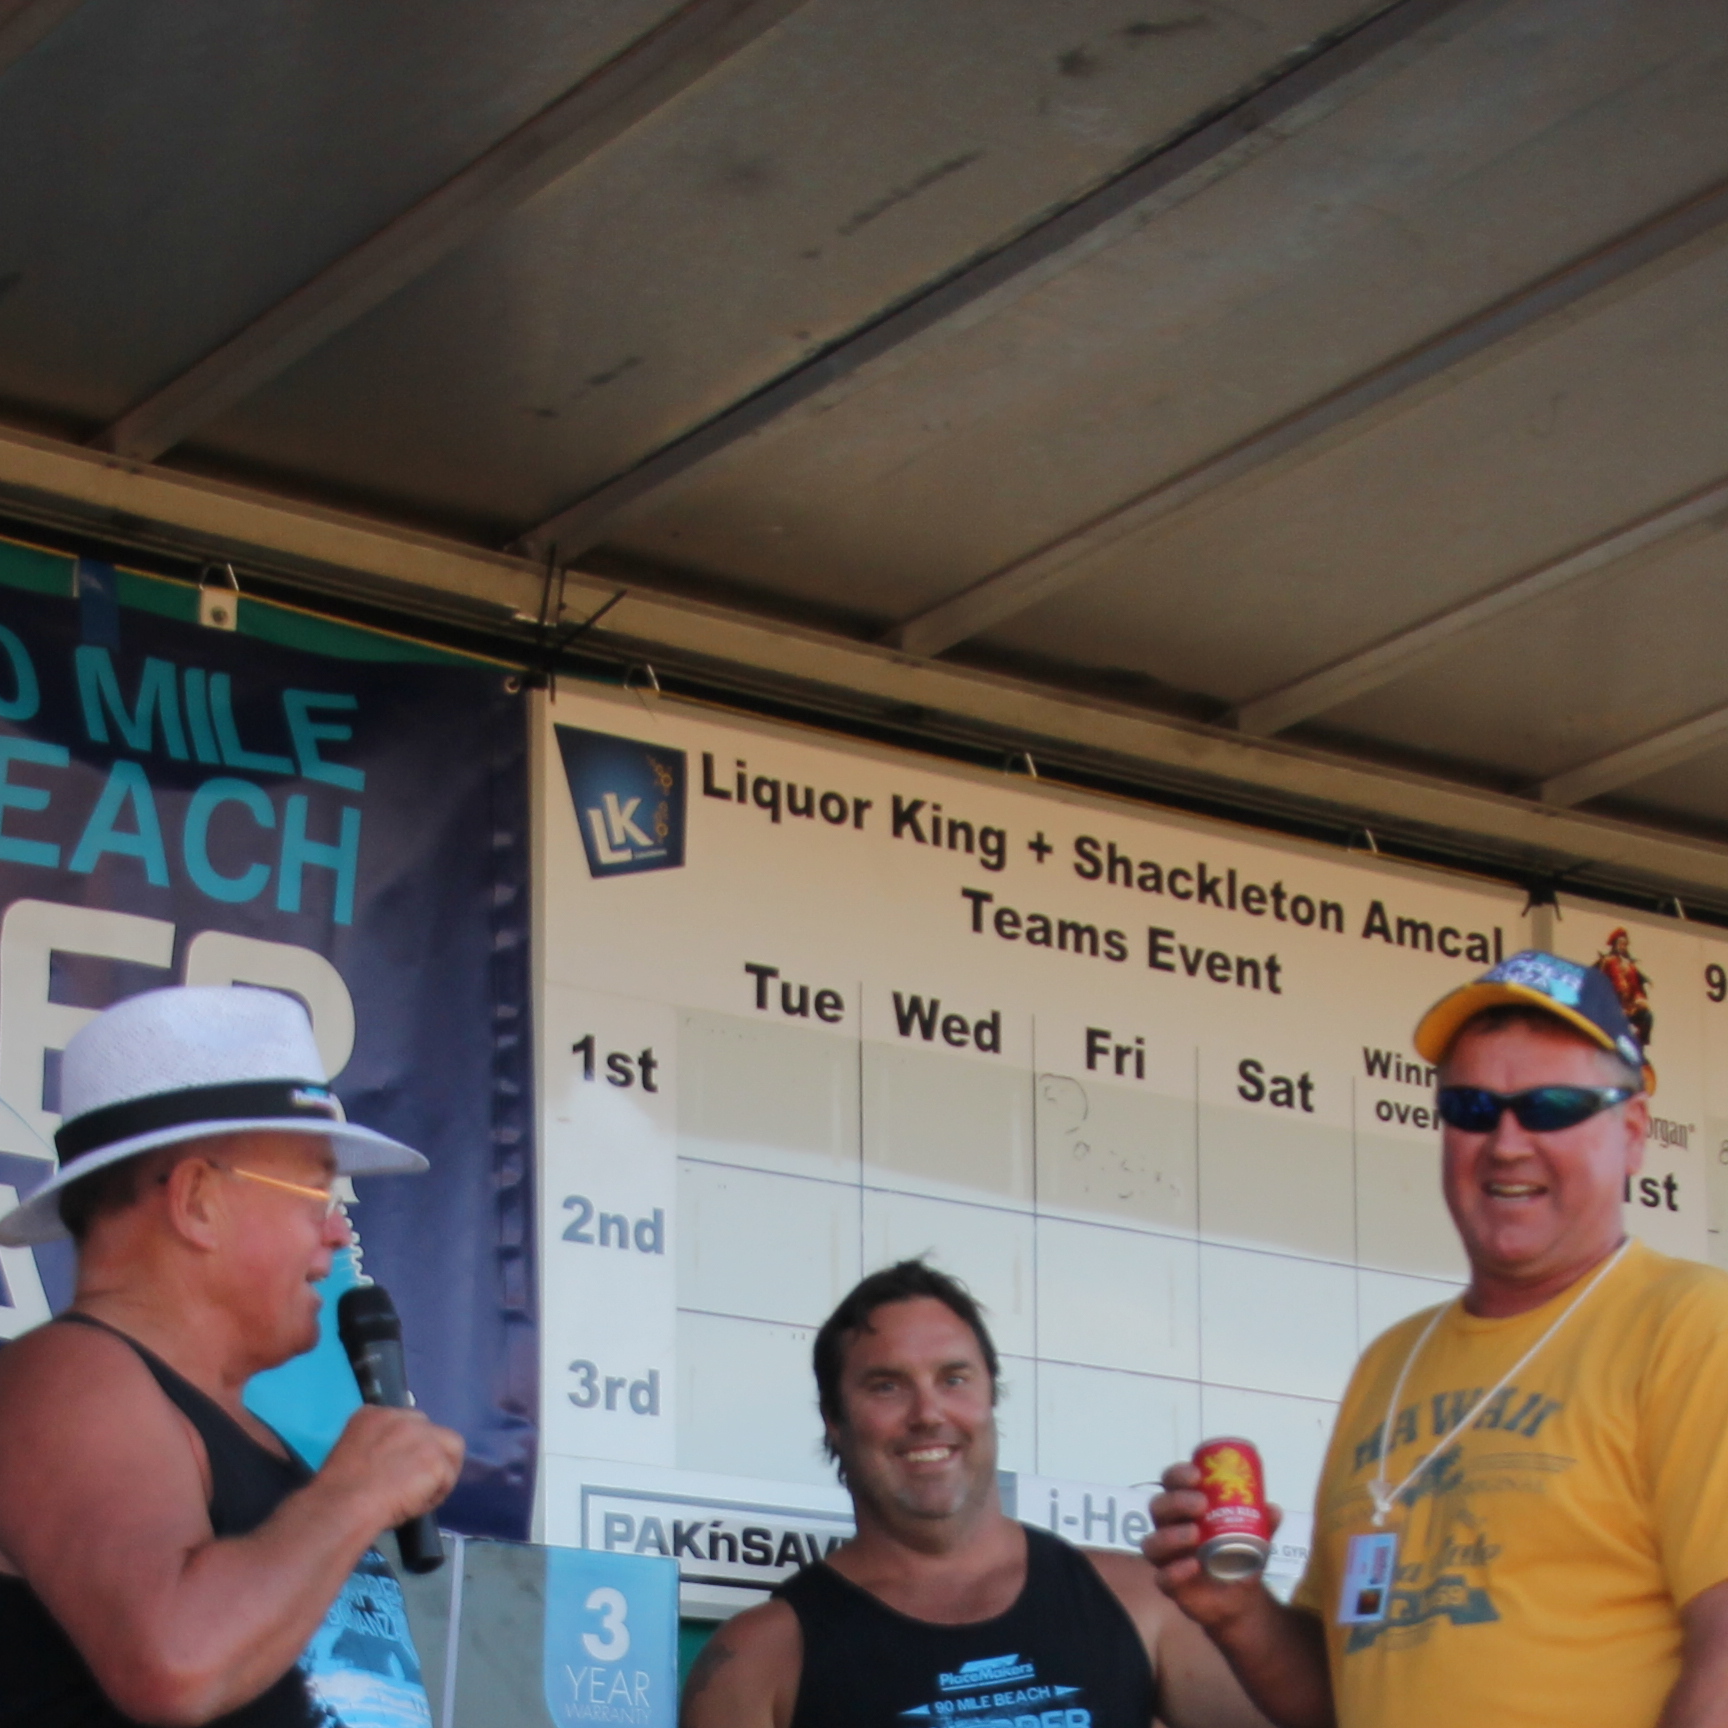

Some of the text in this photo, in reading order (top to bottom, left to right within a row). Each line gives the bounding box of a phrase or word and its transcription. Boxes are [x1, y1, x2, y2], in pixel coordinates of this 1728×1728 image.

[74, 645, 367, 791] MILE
[701, 753, 872, 832] Liquor
[890, 795, 1008, 872] King
[1073, 836, 1344, 934] Shackleton
[1361, 901, 1504, 966] Amcal
[961, 887, 1283, 995] Teams Event
[570, 1035, 658, 1094] 1st
[744, 963, 1315, 1113] Tue Wed Fri Sat
[561, 1195, 665, 1255] 2nd
[566, 1359, 661, 1417] 3rd
[582, 1587, 630, 1661] 3
[565, 1666, 650, 1708] YEAR
[934, 1686, 1051, 1716] 90 MILE BEACH
[939, 1661, 1033, 1687] PlaceMakers
[565, 1704, 651, 1725] WARRANTY
